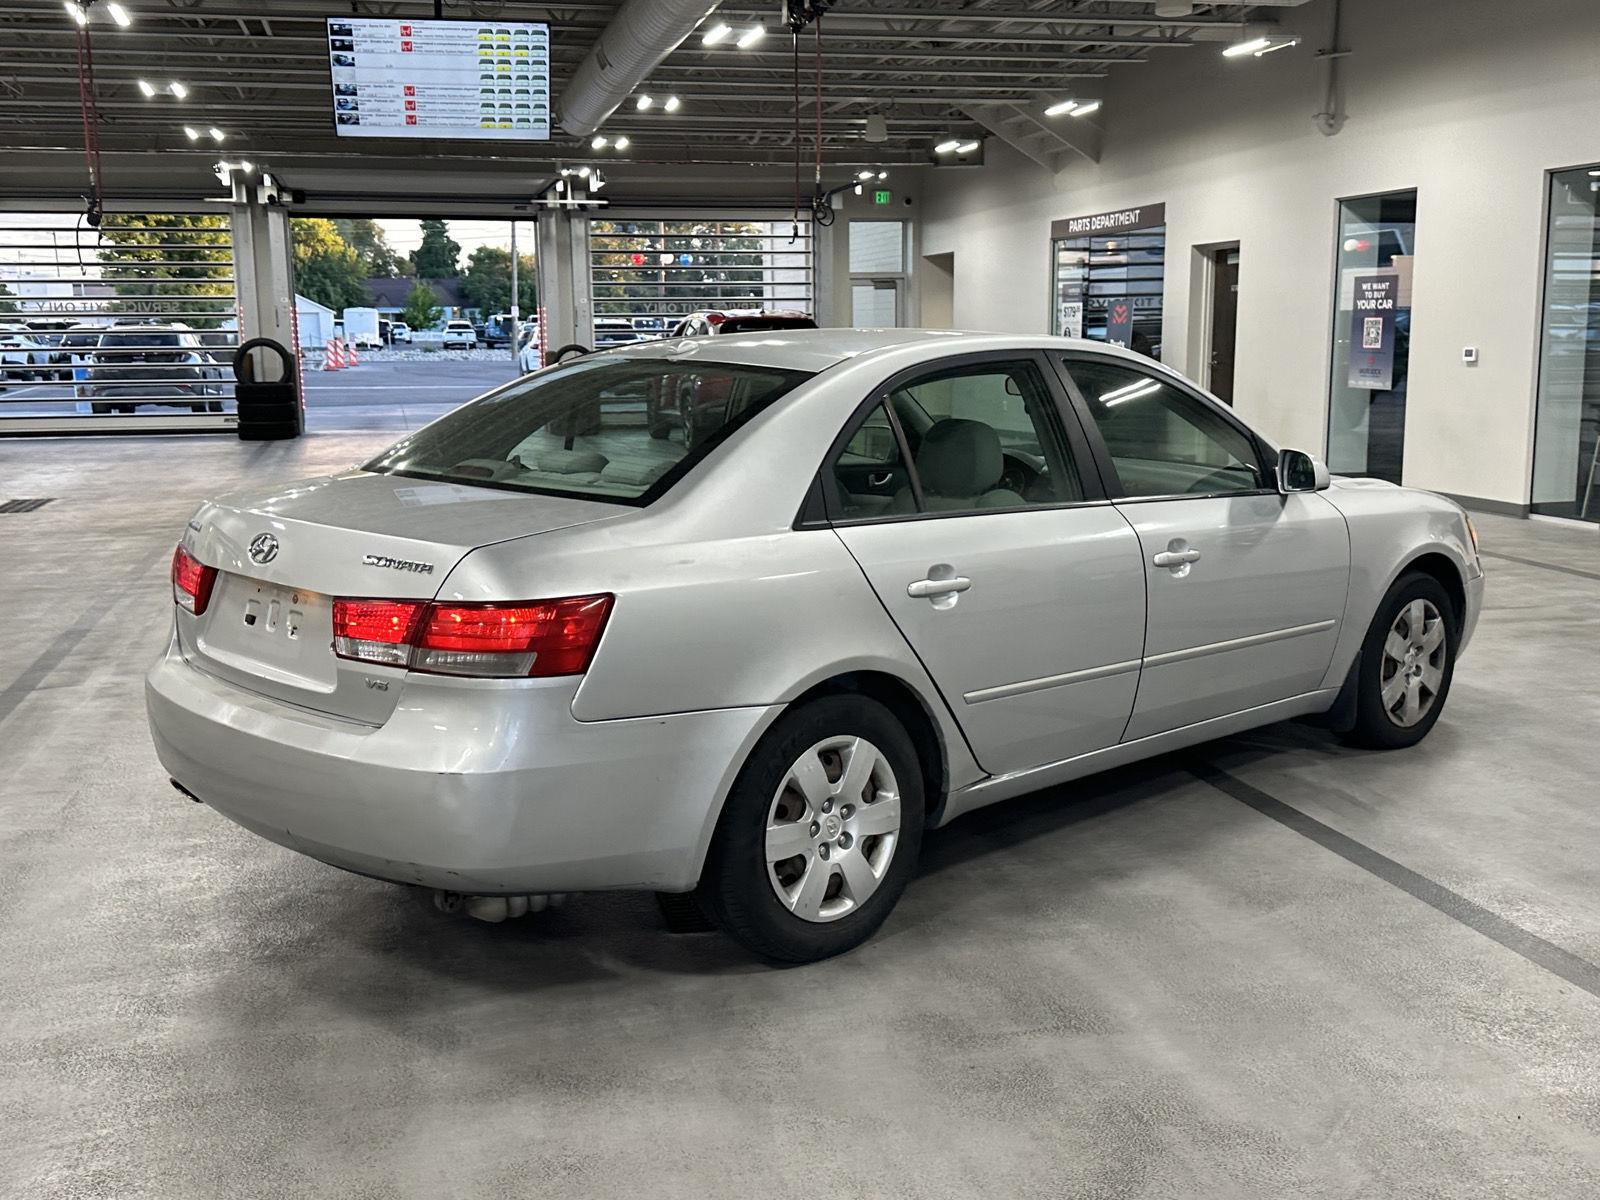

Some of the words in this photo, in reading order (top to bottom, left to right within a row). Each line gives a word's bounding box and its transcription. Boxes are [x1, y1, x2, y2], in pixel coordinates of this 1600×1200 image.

[875, 191, 890, 204] EXIT
[1068, 218, 1090, 232] PARTS
[1091, 210, 1140, 230] DEPARTMENT
[1372, 281, 1389, 290] WANT
[1357, 299, 1377, 310] YOUR
[1377, 299, 1393, 310] CAR
[362, 554, 435, 574] SONATA
[365, 677, 390, 691] V6
